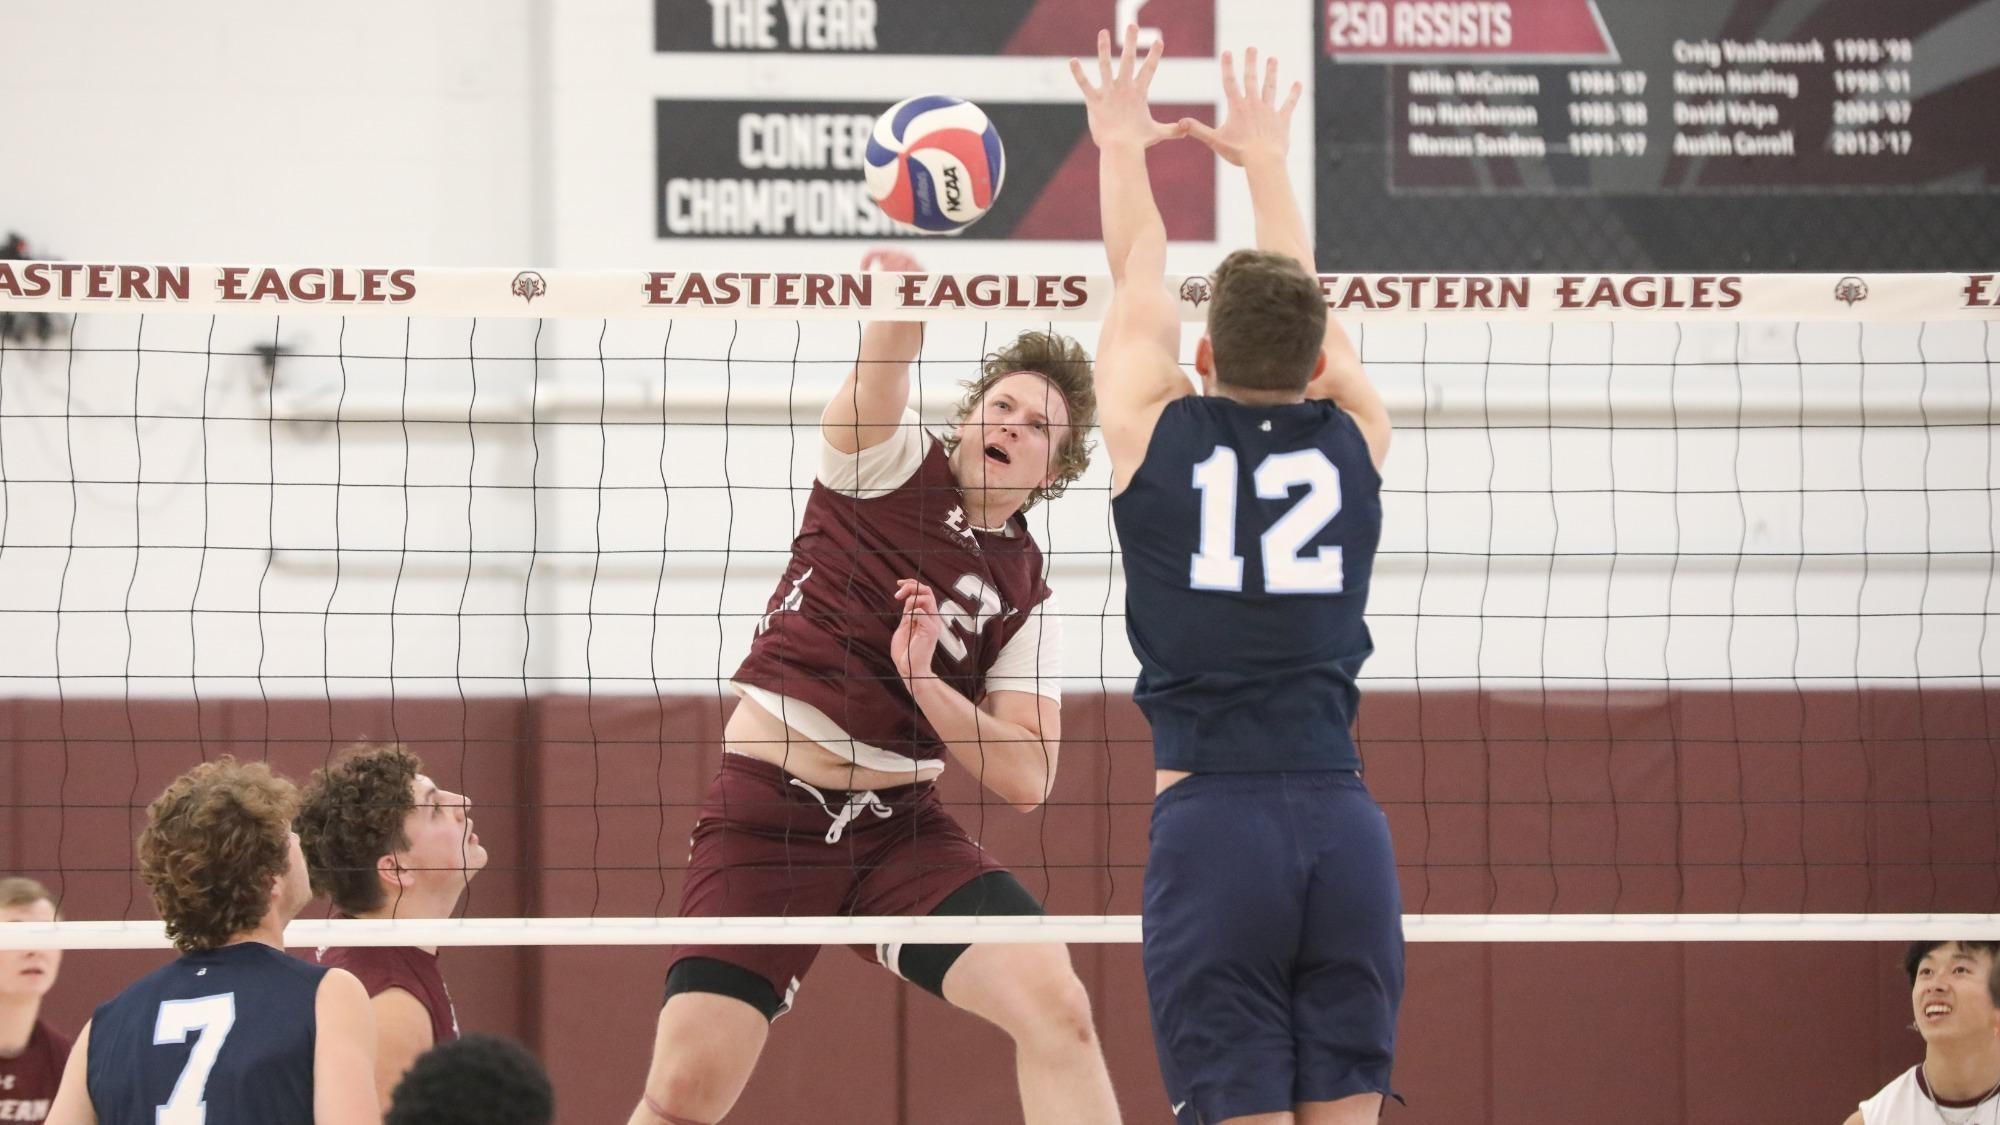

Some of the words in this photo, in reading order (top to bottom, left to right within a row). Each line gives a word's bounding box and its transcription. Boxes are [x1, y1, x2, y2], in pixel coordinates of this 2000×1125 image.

[706, 0, 779, 49] THE
[780, 0, 879, 49] YEAR
[1329, 1, 1389, 47] 250
[1393, 2, 1513, 47] ASSISTS
[1673, 100, 1726, 125] David
[1673, 131, 1732, 156] Austin
[666, 177, 960, 235] CHAMPIONS
[943, 165, 962, 213] NCAA
[217, 267, 417, 302] EAGLES
[644, 272, 872, 306] EASTERN
[898, 273, 1088, 307] EAGLES
[1556, 276, 1742, 308] EAGLES
[1190, 445, 1343, 594] 12
[153, 992, 236, 1125] 7
